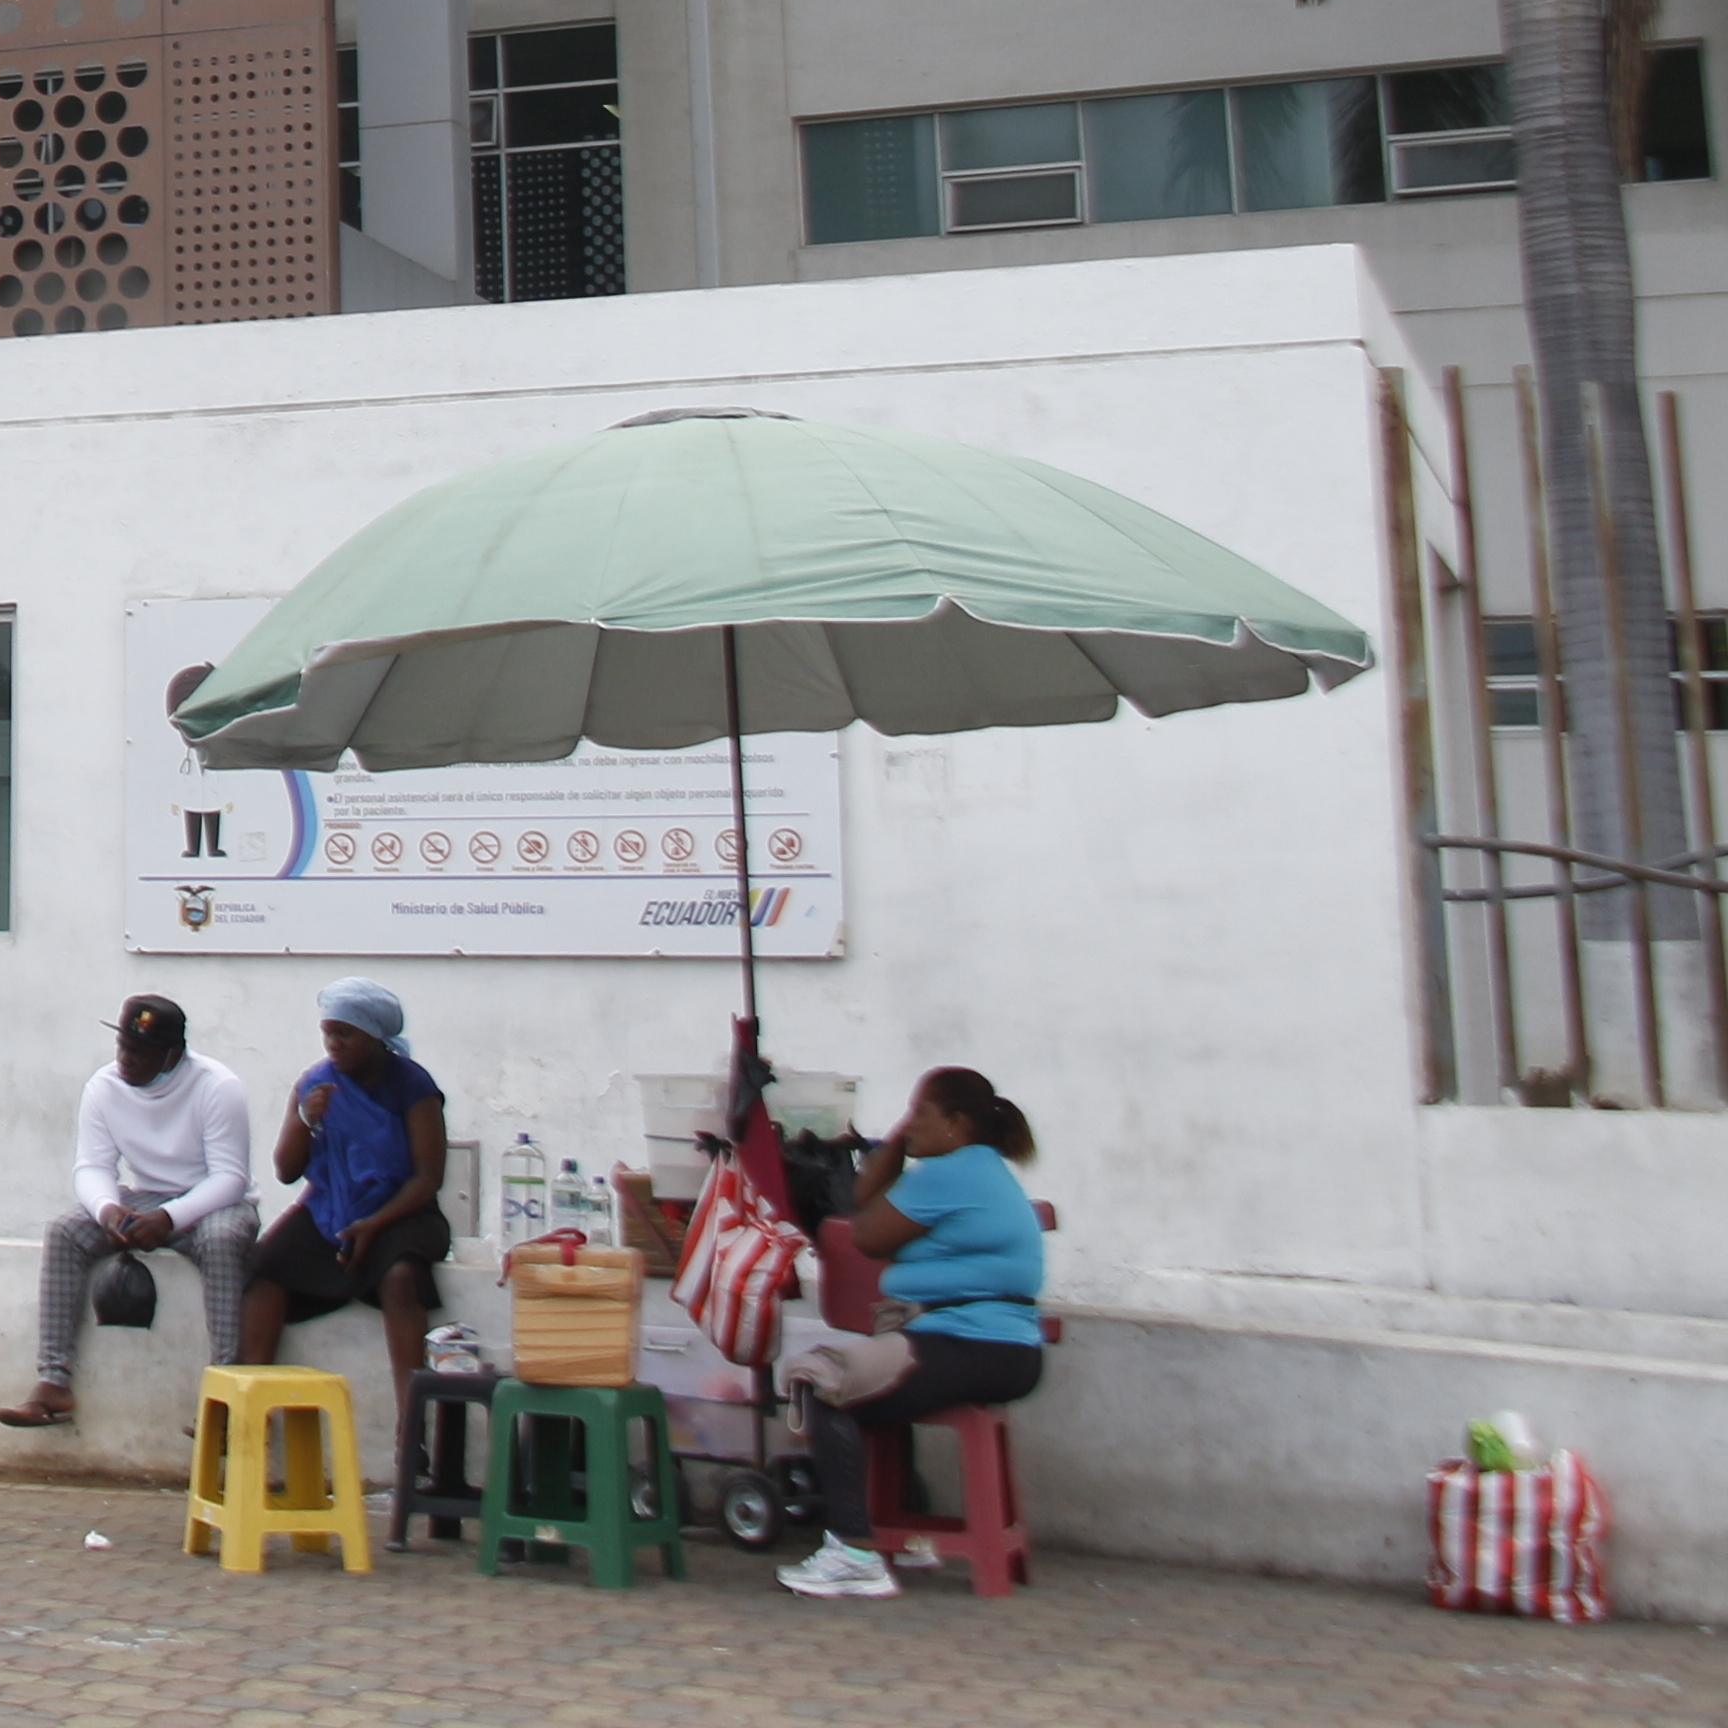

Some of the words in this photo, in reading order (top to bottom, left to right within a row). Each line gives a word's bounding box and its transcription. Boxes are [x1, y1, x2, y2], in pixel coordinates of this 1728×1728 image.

[578, 758, 592, 766] no
[594, 756, 617, 766] debe
[619, 755, 661, 767] ingresar
[663, 756, 682, 765] con
[685, 753, 730, 764] mochilas
[334, 773, 375, 785] grandes.
[345, 793, 385, 805] personal
[388, 792, 439, 803] asistencial
[465, 792, 475, 802] el
[506, 790, 565, 803] responsable
[567, 790, 580, 800] de
[581, 789, 621, 800] solicitar
[655, 788, 686, 801] objeto
[689, 788, 732, 801] personal
[334, 807, 350, 817] por
[352, 806, 361, 815] la
[363, 806, 407, 817] paciente.
[391, 901, 447, 915] Ministerio
[450, 902, 464, 915] de
[467, 901, 496, 915] Salud
[501, 901, 544, 915] Pública
[638, 901, 741, 926] ECUADOR
